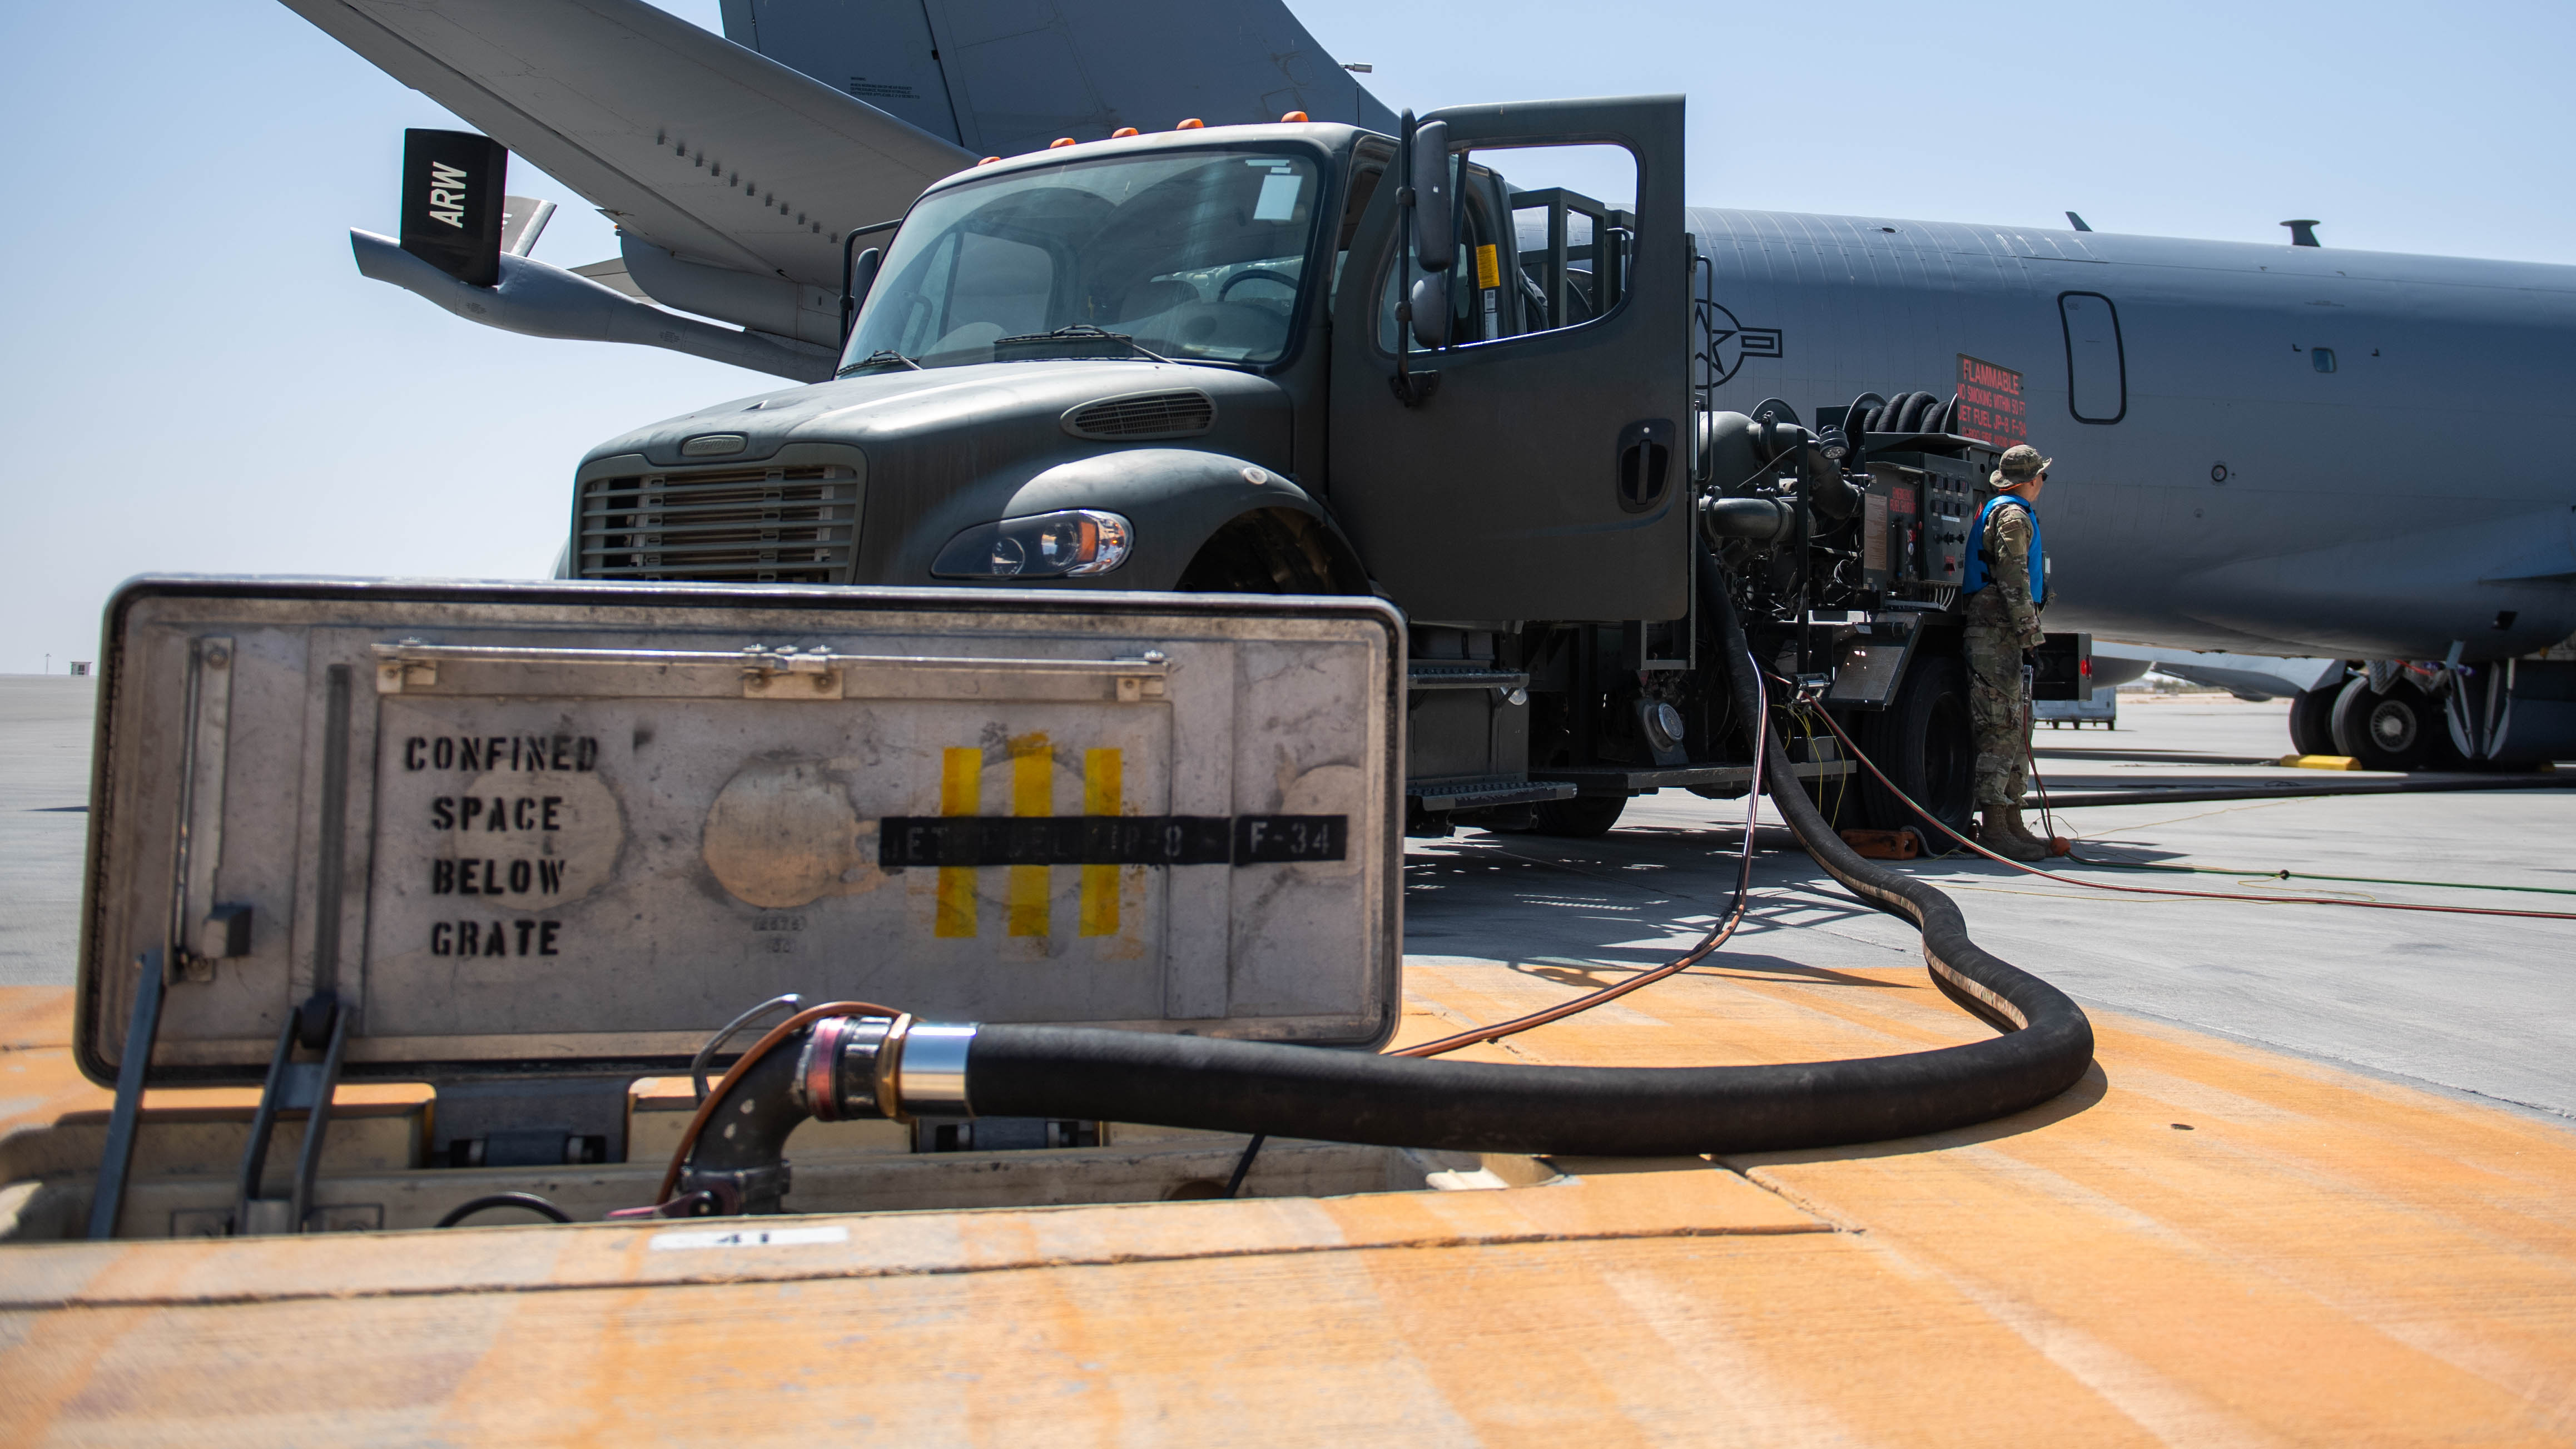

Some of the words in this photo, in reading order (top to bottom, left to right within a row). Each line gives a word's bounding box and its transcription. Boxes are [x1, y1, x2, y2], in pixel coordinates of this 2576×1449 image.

[429, 161, 467, 228] ARW
[1963, 359, 2020, 395] FLAMMABLE
[1957, 383, 1965, 400] NO
[1967, 386, 1992, 408] SMOKING
[1993, 393, 2011, 413] WITHIN
[2012, 399, 2018, 415] 50
[2019, 401, 2026, 417] FT
[1957, 405, 1971, 422] JET
[1973, 408, 1992, 428] FUEL
[1994, 414, 2009, 433] JP-8
[2012, 419, 2027, 436] F-34
[405, 736, 599, 772] CONFINED
[431, 796, 563, 832] SPACE
[1250, 821, 1330, 855] F-34
[432, 859, 566, 895] BELOW
[431, 920, 562, 956] GRATE
